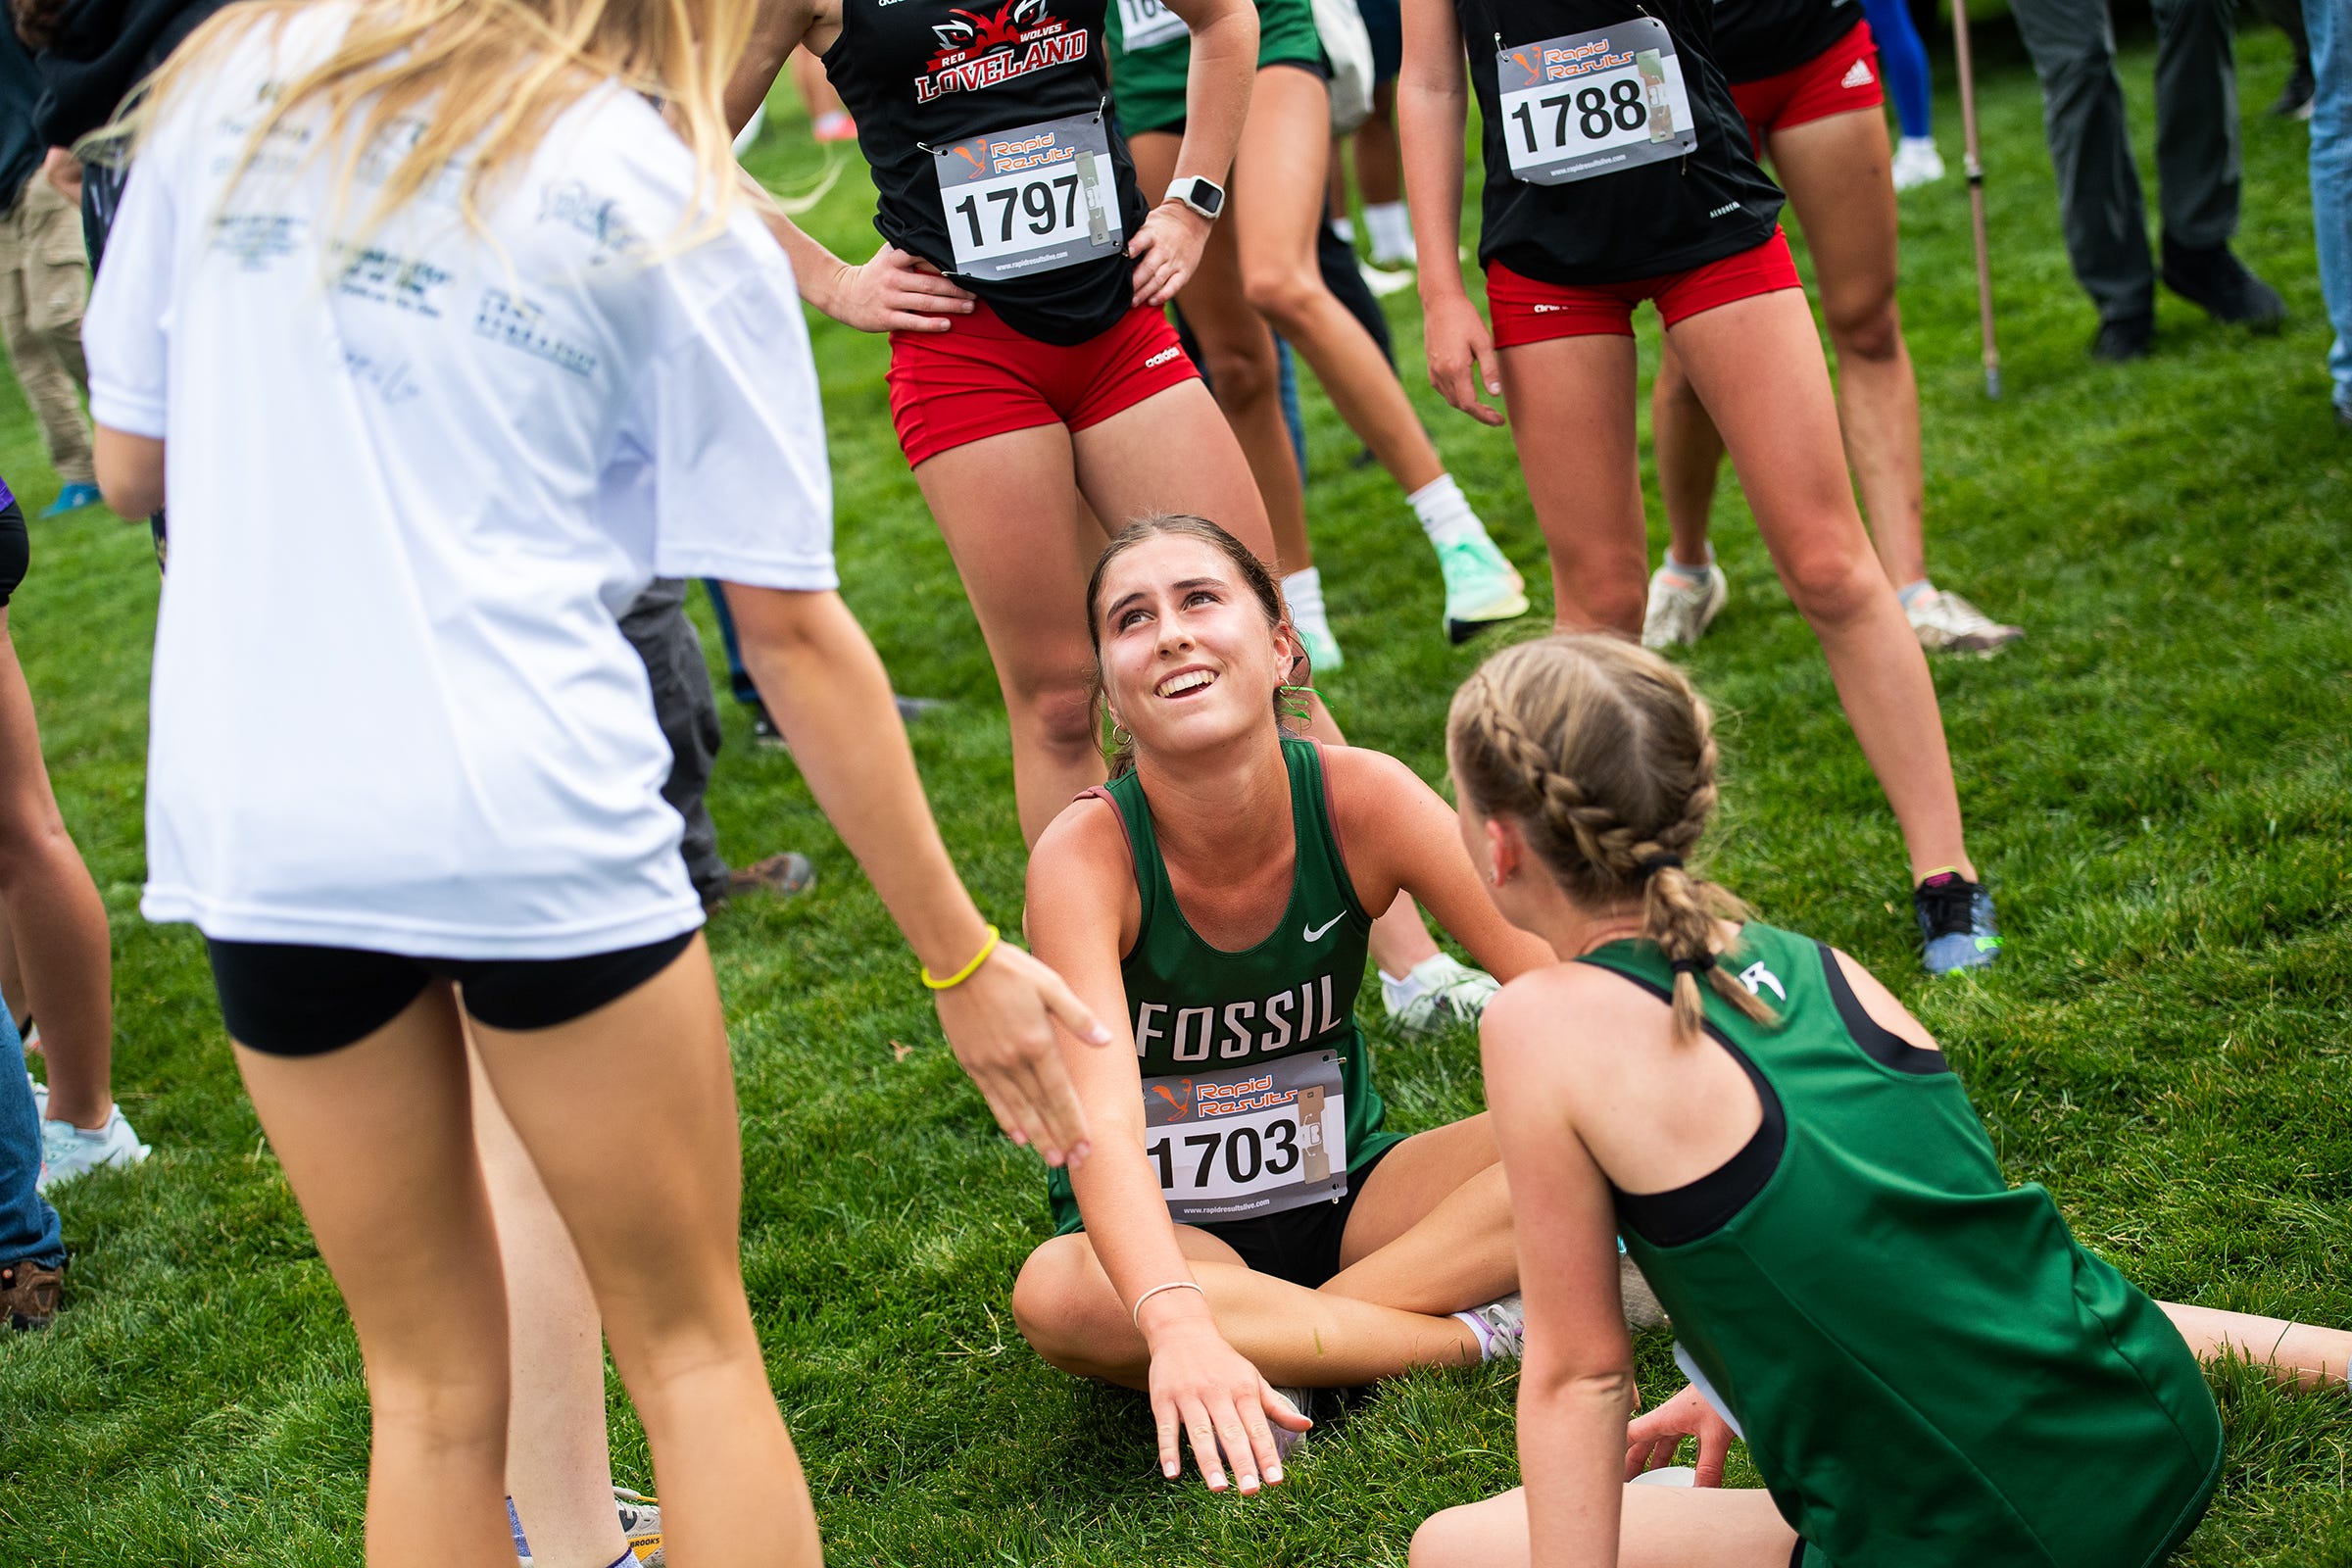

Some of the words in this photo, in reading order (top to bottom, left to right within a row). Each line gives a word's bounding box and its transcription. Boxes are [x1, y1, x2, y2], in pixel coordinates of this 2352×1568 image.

[941, 52, 966, 68] RED
[1019, 23, 1062, 43] WOLVES
[1544, 38, 1610, 66] Rapid
[914, 28, 1089, 104] LOVELAND
[1546, 50, 1635, 81] Results
[1511, 79, 1647, 153] 1788
[990, 131, 1056, 157] Rapid
[994, 146, 1075, 174] Results
[956, 174, 1080, 247] 1797
[1136, 974, 1343, 1061] FOSSIL
[1196, 1074, 1273, 1101] Rapid
[1199, 1089, 1298, 1118] Results
[1146, 1118, 1300, 1190] 1703
[1183, 1198, 1270, 1215] www.rapidresultslive.com
[629, 1538, 660, 1547] BROOKS
